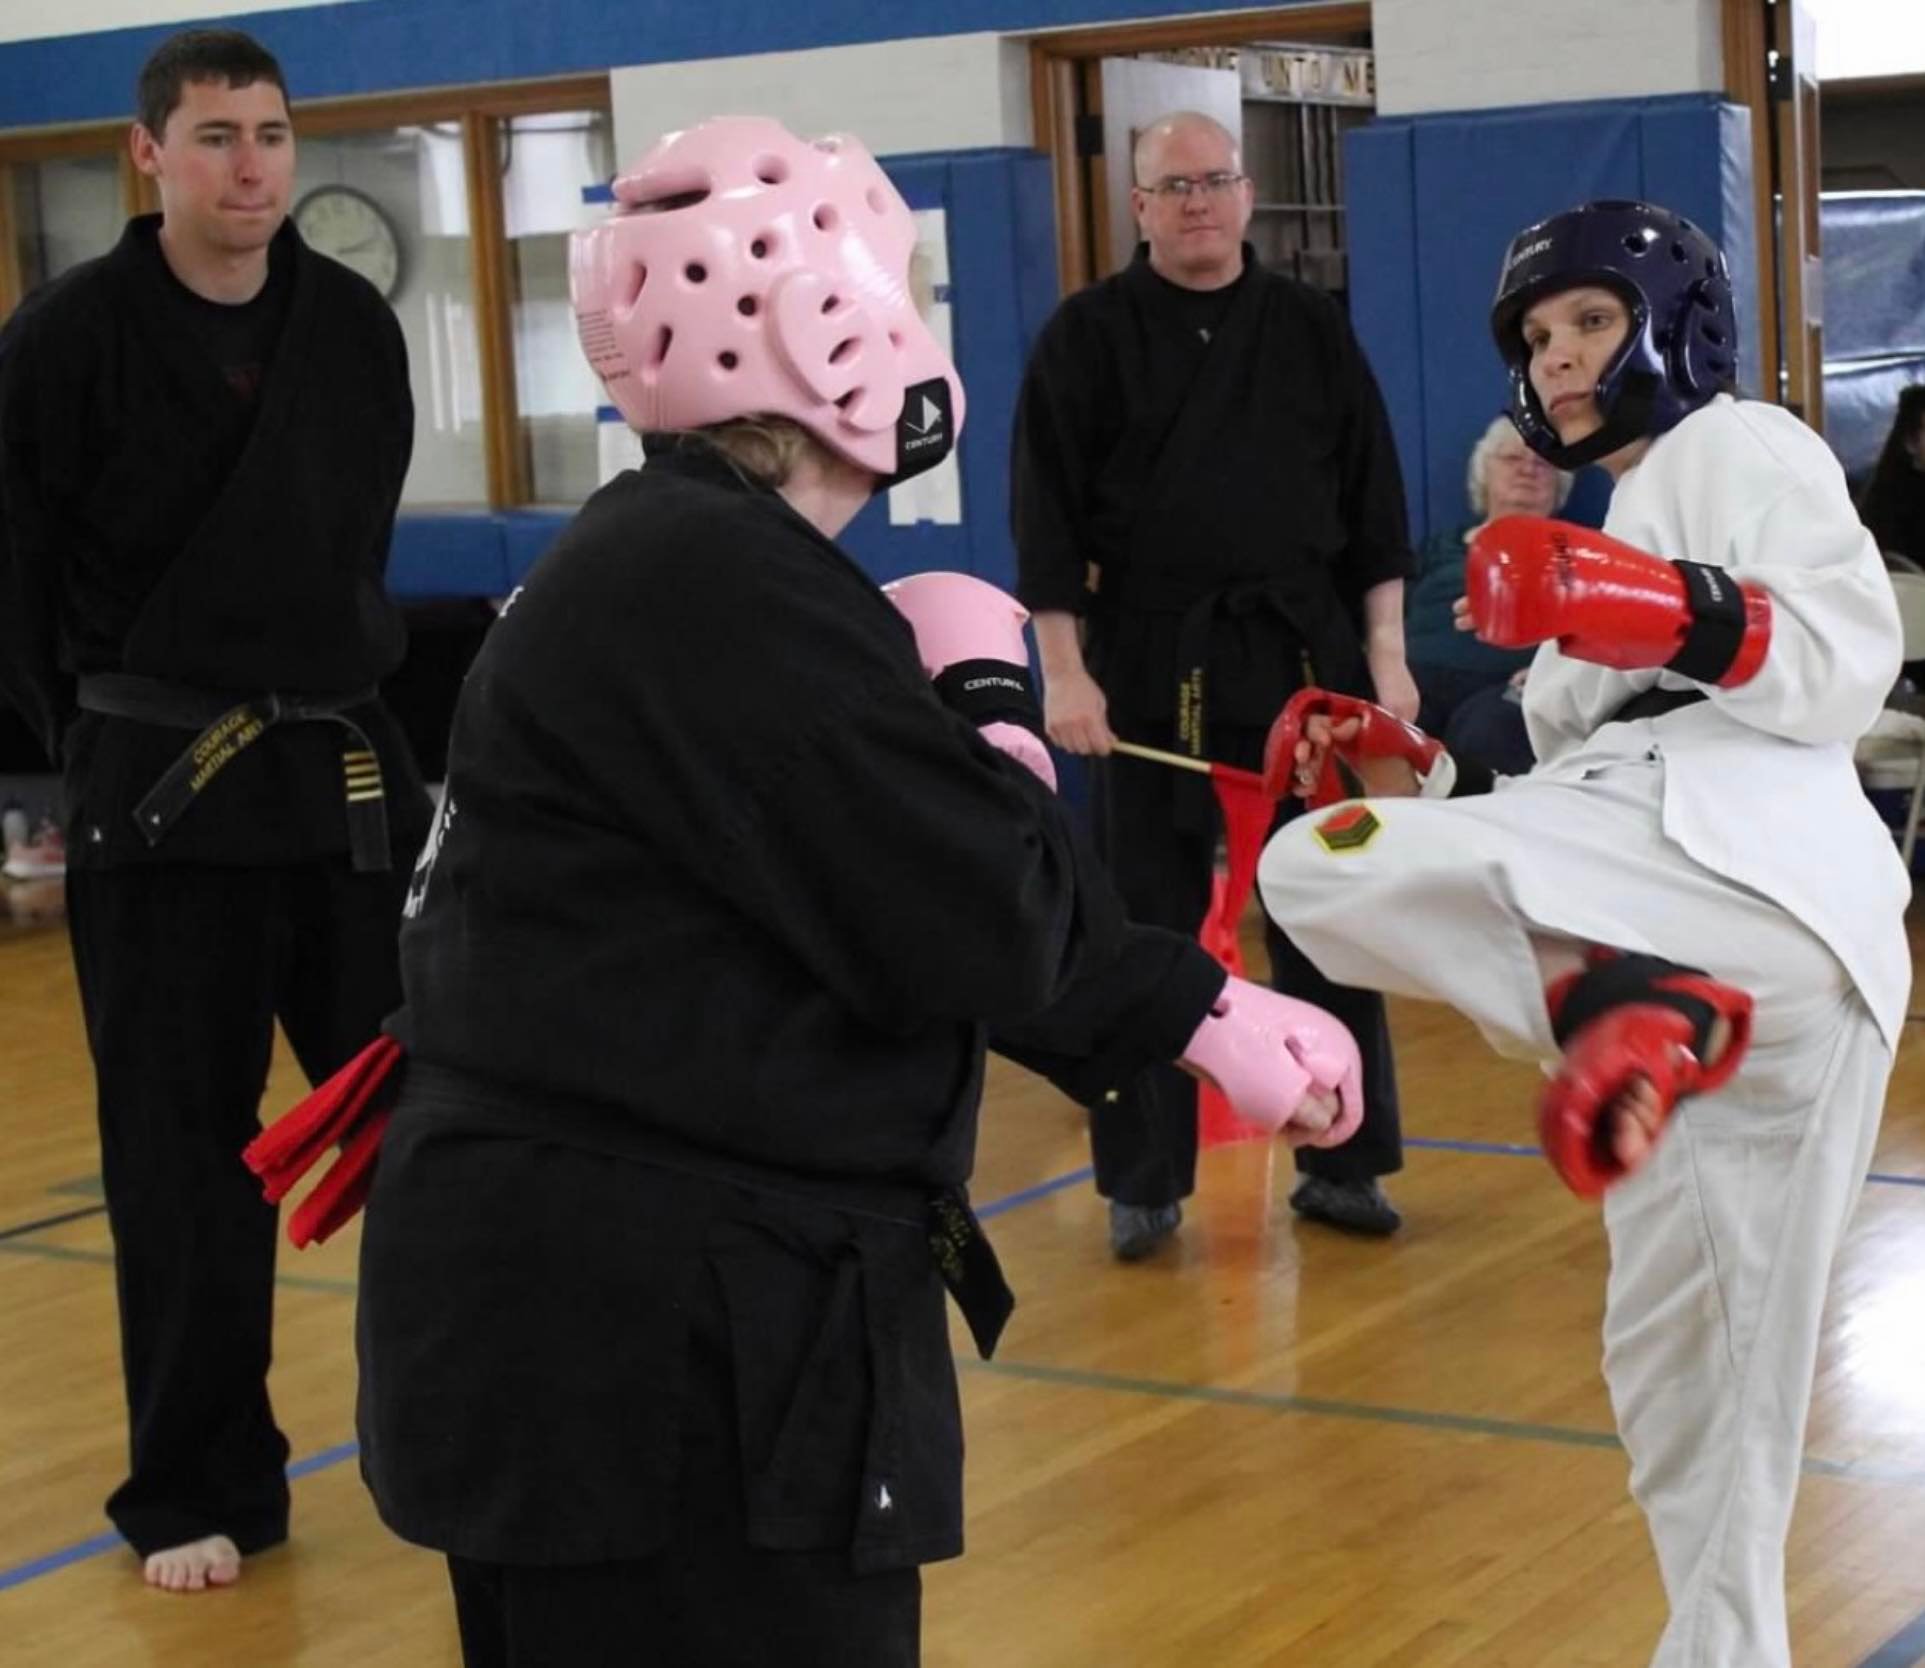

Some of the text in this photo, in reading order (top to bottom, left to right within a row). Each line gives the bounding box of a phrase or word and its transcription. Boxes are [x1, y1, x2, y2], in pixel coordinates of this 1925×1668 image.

[963, 676, 1025, 691] CENTURY
[194, 711, 248, 764] COURAGE
[190, 742, 237, 791] MARTIAL
